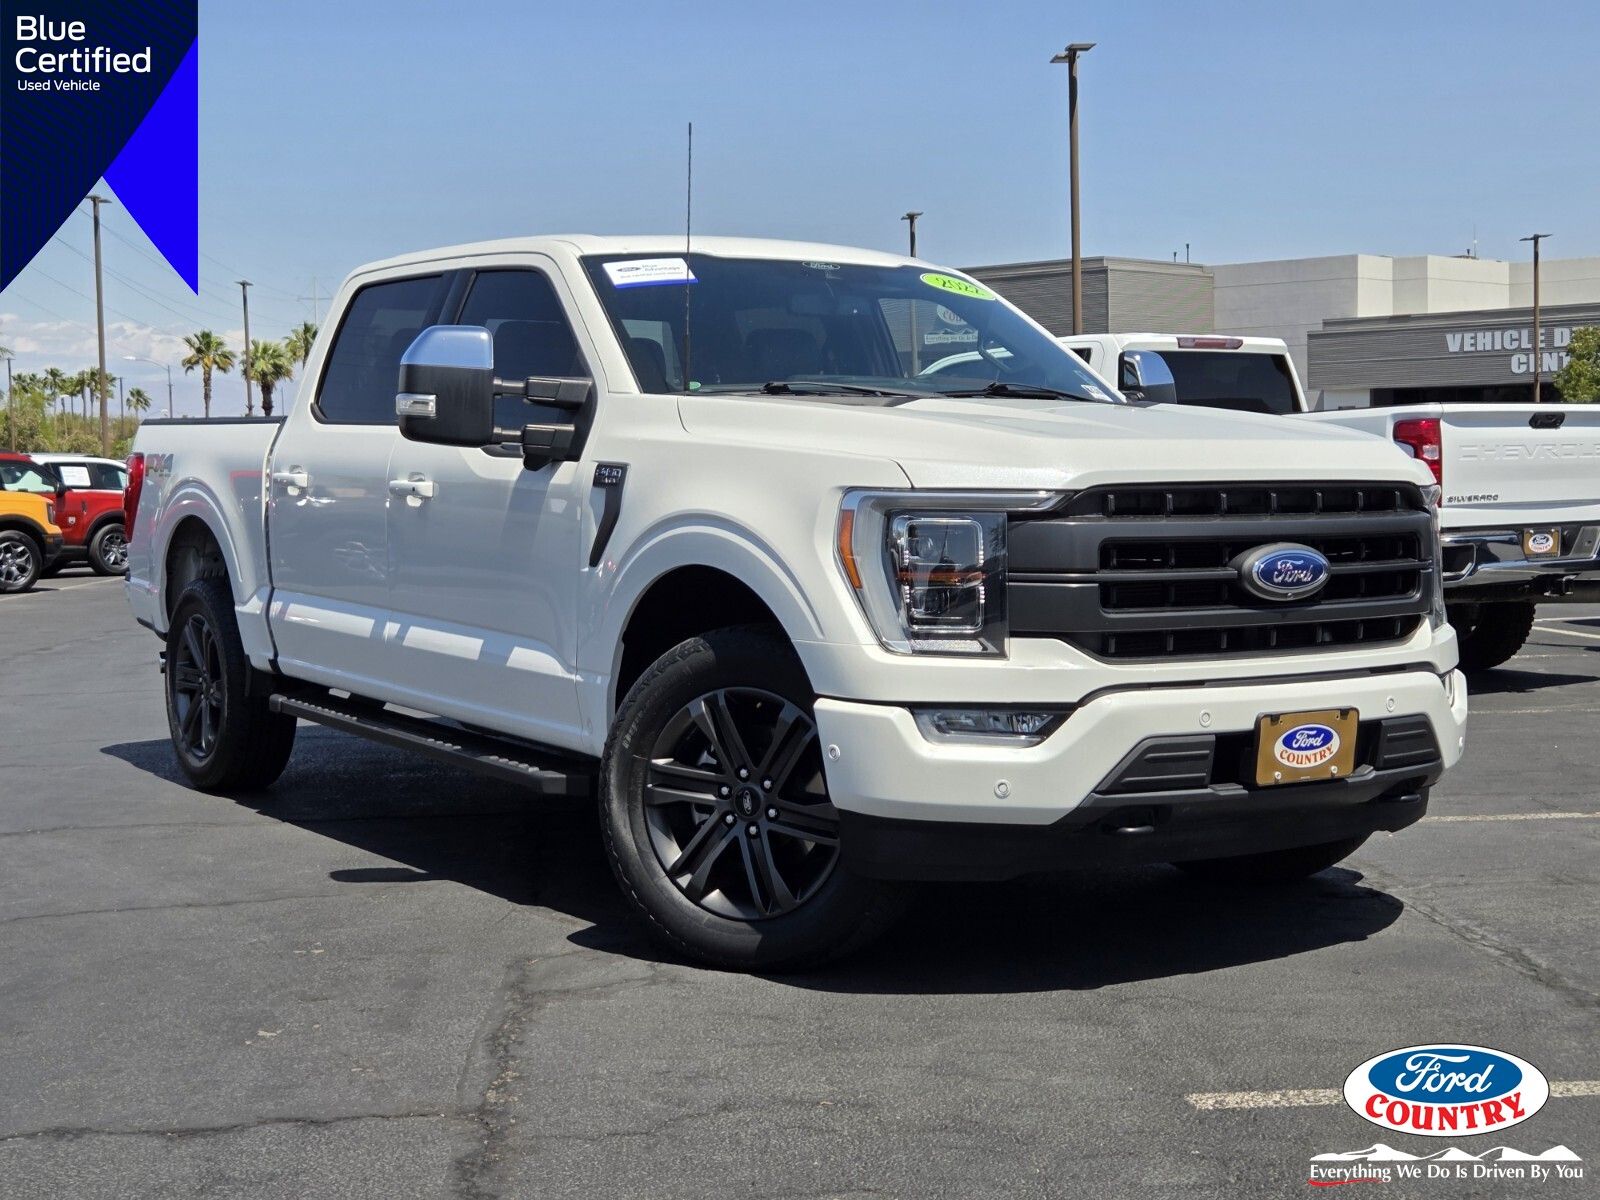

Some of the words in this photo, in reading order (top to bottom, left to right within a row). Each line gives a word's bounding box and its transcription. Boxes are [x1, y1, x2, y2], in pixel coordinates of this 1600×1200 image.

[1445, 328, 1545, 353] VEHICLE
[1554, 327, 1571, 348] D
[1447, 494, 1499, 503] SILVERADO
[1272, 559, 1314, 584] Ford
[1291, 730, 1325, 749] Ford
[1279, 743, 1334, 765] COUNTRY
